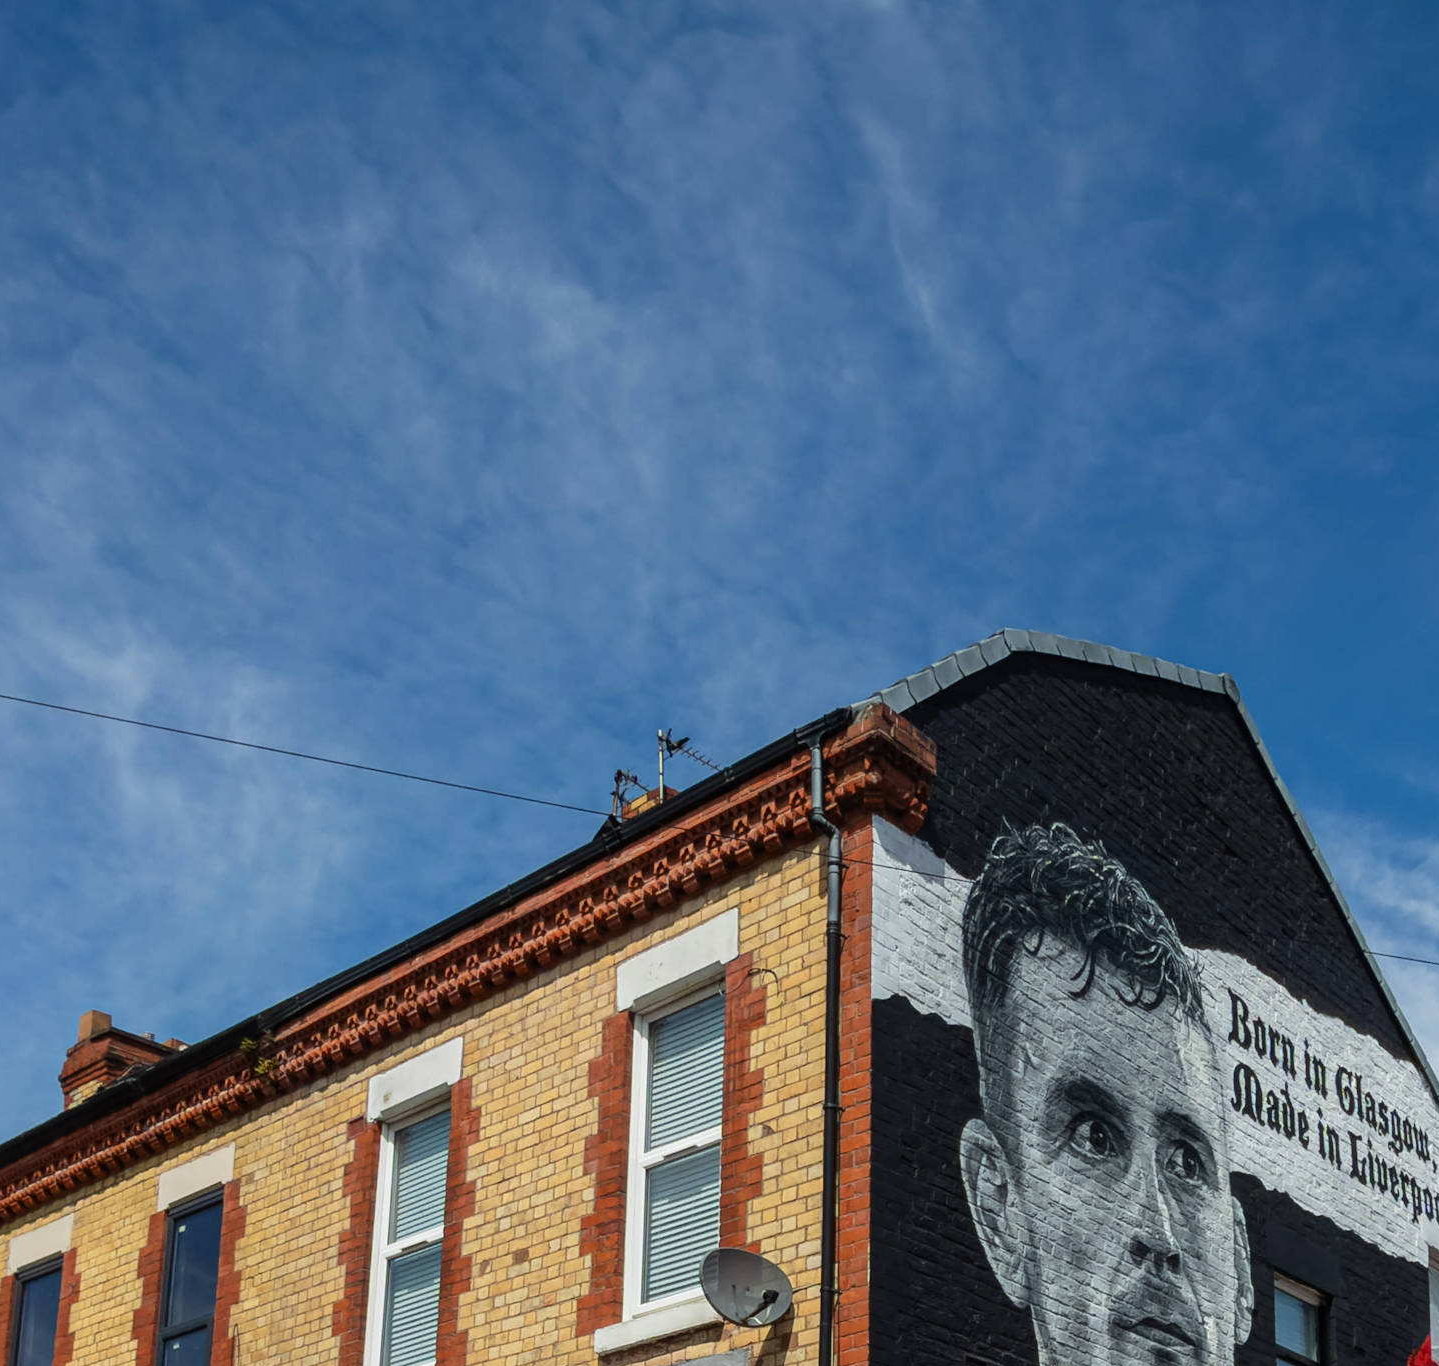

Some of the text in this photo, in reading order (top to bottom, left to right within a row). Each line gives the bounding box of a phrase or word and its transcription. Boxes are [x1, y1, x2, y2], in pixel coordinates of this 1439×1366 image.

[1228, 987, 1297, 1080] Born
[1304, 1037, 1328, 1099] in
[1230, 1063, 1310, 1149] Made
[1317, 1107, 1342, 1170] in
